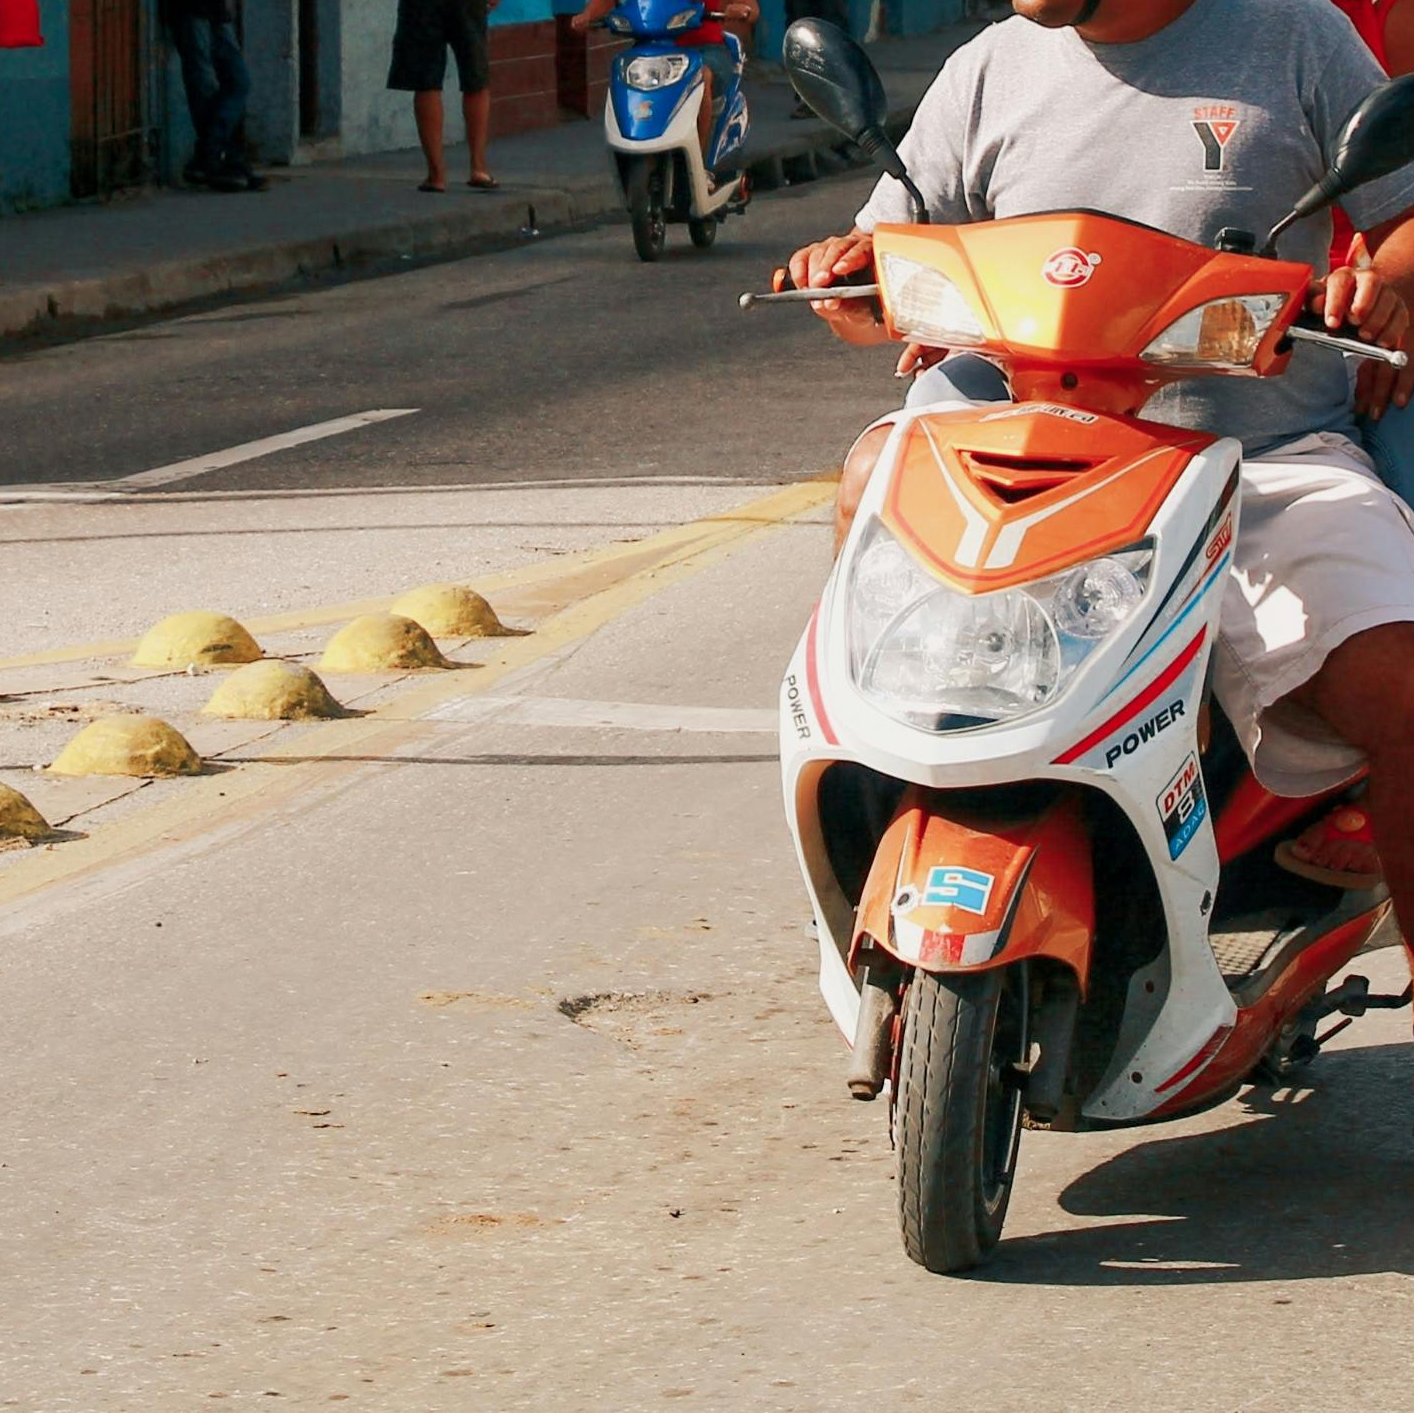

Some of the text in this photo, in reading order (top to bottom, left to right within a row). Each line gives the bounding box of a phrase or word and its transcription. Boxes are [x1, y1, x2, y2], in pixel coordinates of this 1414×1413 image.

[1194, 106, 1236, 119] STAFF
[786, 674, 811, 739] POWER
[1105, 699, 1186, 768] POWER
[1164, 761, 1196, 813] DTM
[1177, 790, 1195, 825] 8
